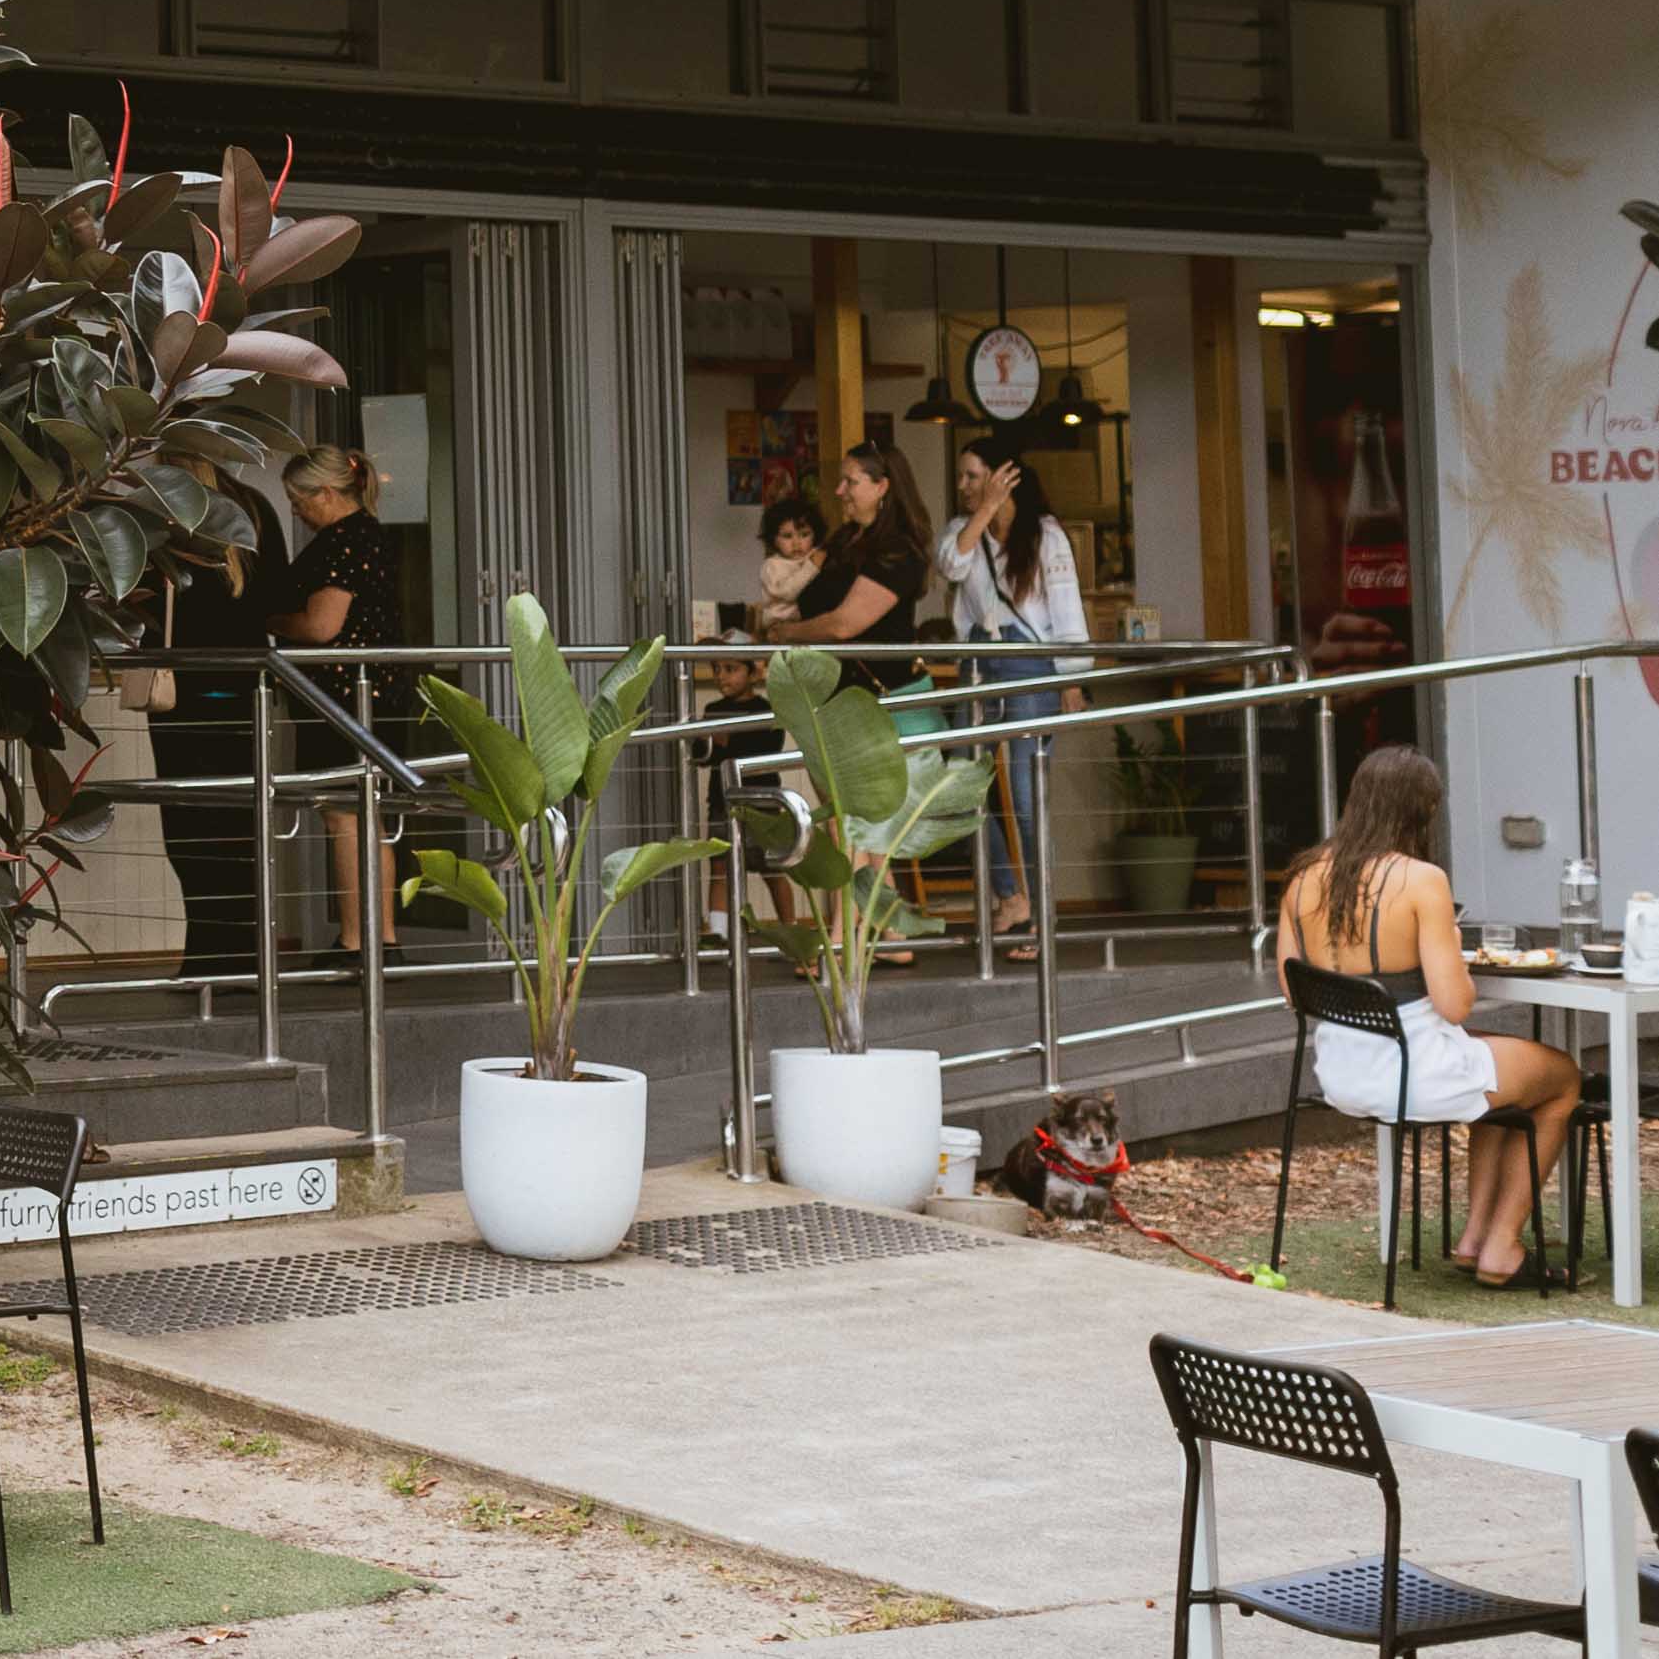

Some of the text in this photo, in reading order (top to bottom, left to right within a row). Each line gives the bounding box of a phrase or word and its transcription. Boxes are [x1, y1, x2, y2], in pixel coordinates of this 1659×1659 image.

[1585, 396, 1659, 444] Nora
[1550, 448, 1659, 484] BEAC
[0, 1197, 60, 1233] furry
[165, 1186, 219, 1220] past
[228, 1177, 283, 1207] here
